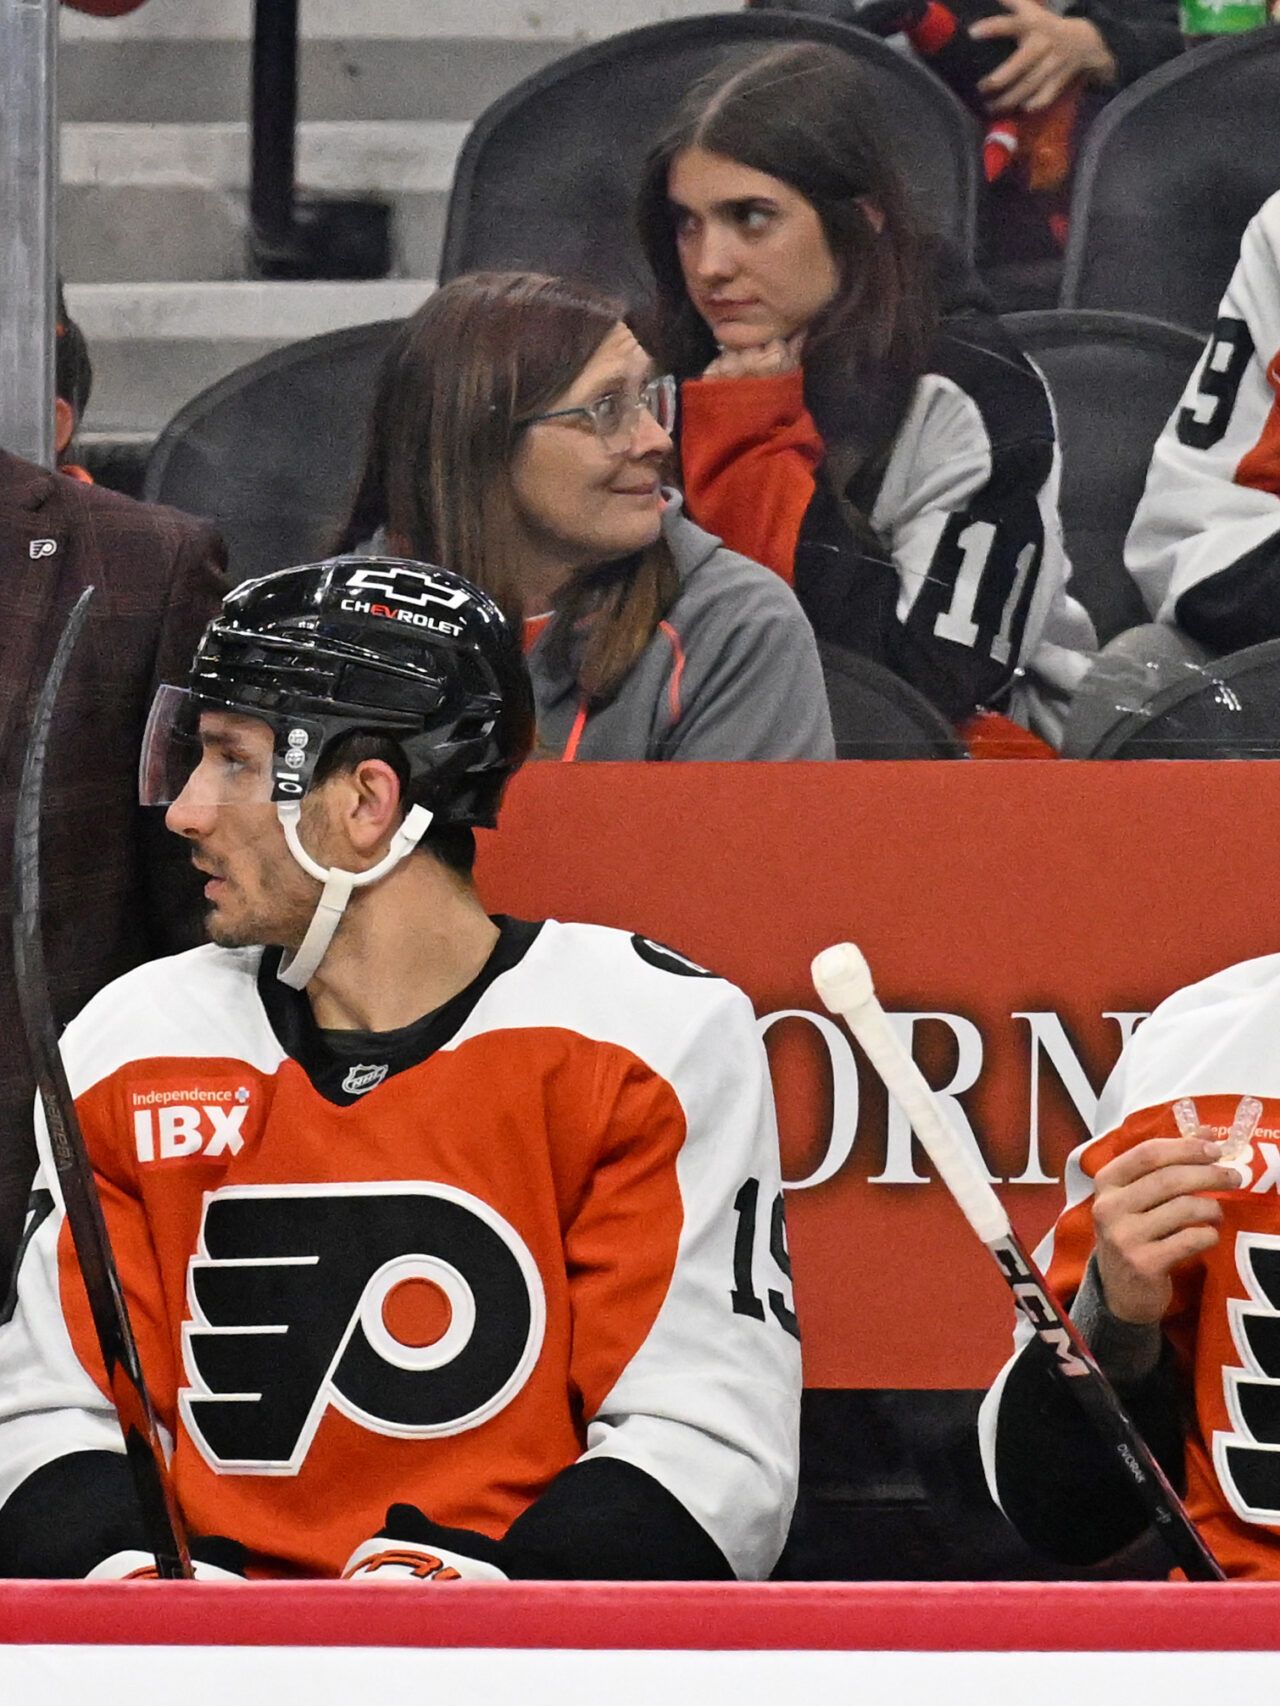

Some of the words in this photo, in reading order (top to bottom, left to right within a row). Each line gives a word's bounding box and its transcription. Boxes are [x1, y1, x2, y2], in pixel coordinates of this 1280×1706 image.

[933, 520, 1037, 665] 11
[340, 599, 464, 637] CHEVROLET
[132, 1087, 232, 1106] Independence
[133, 1105, 249, 1163] IBX
